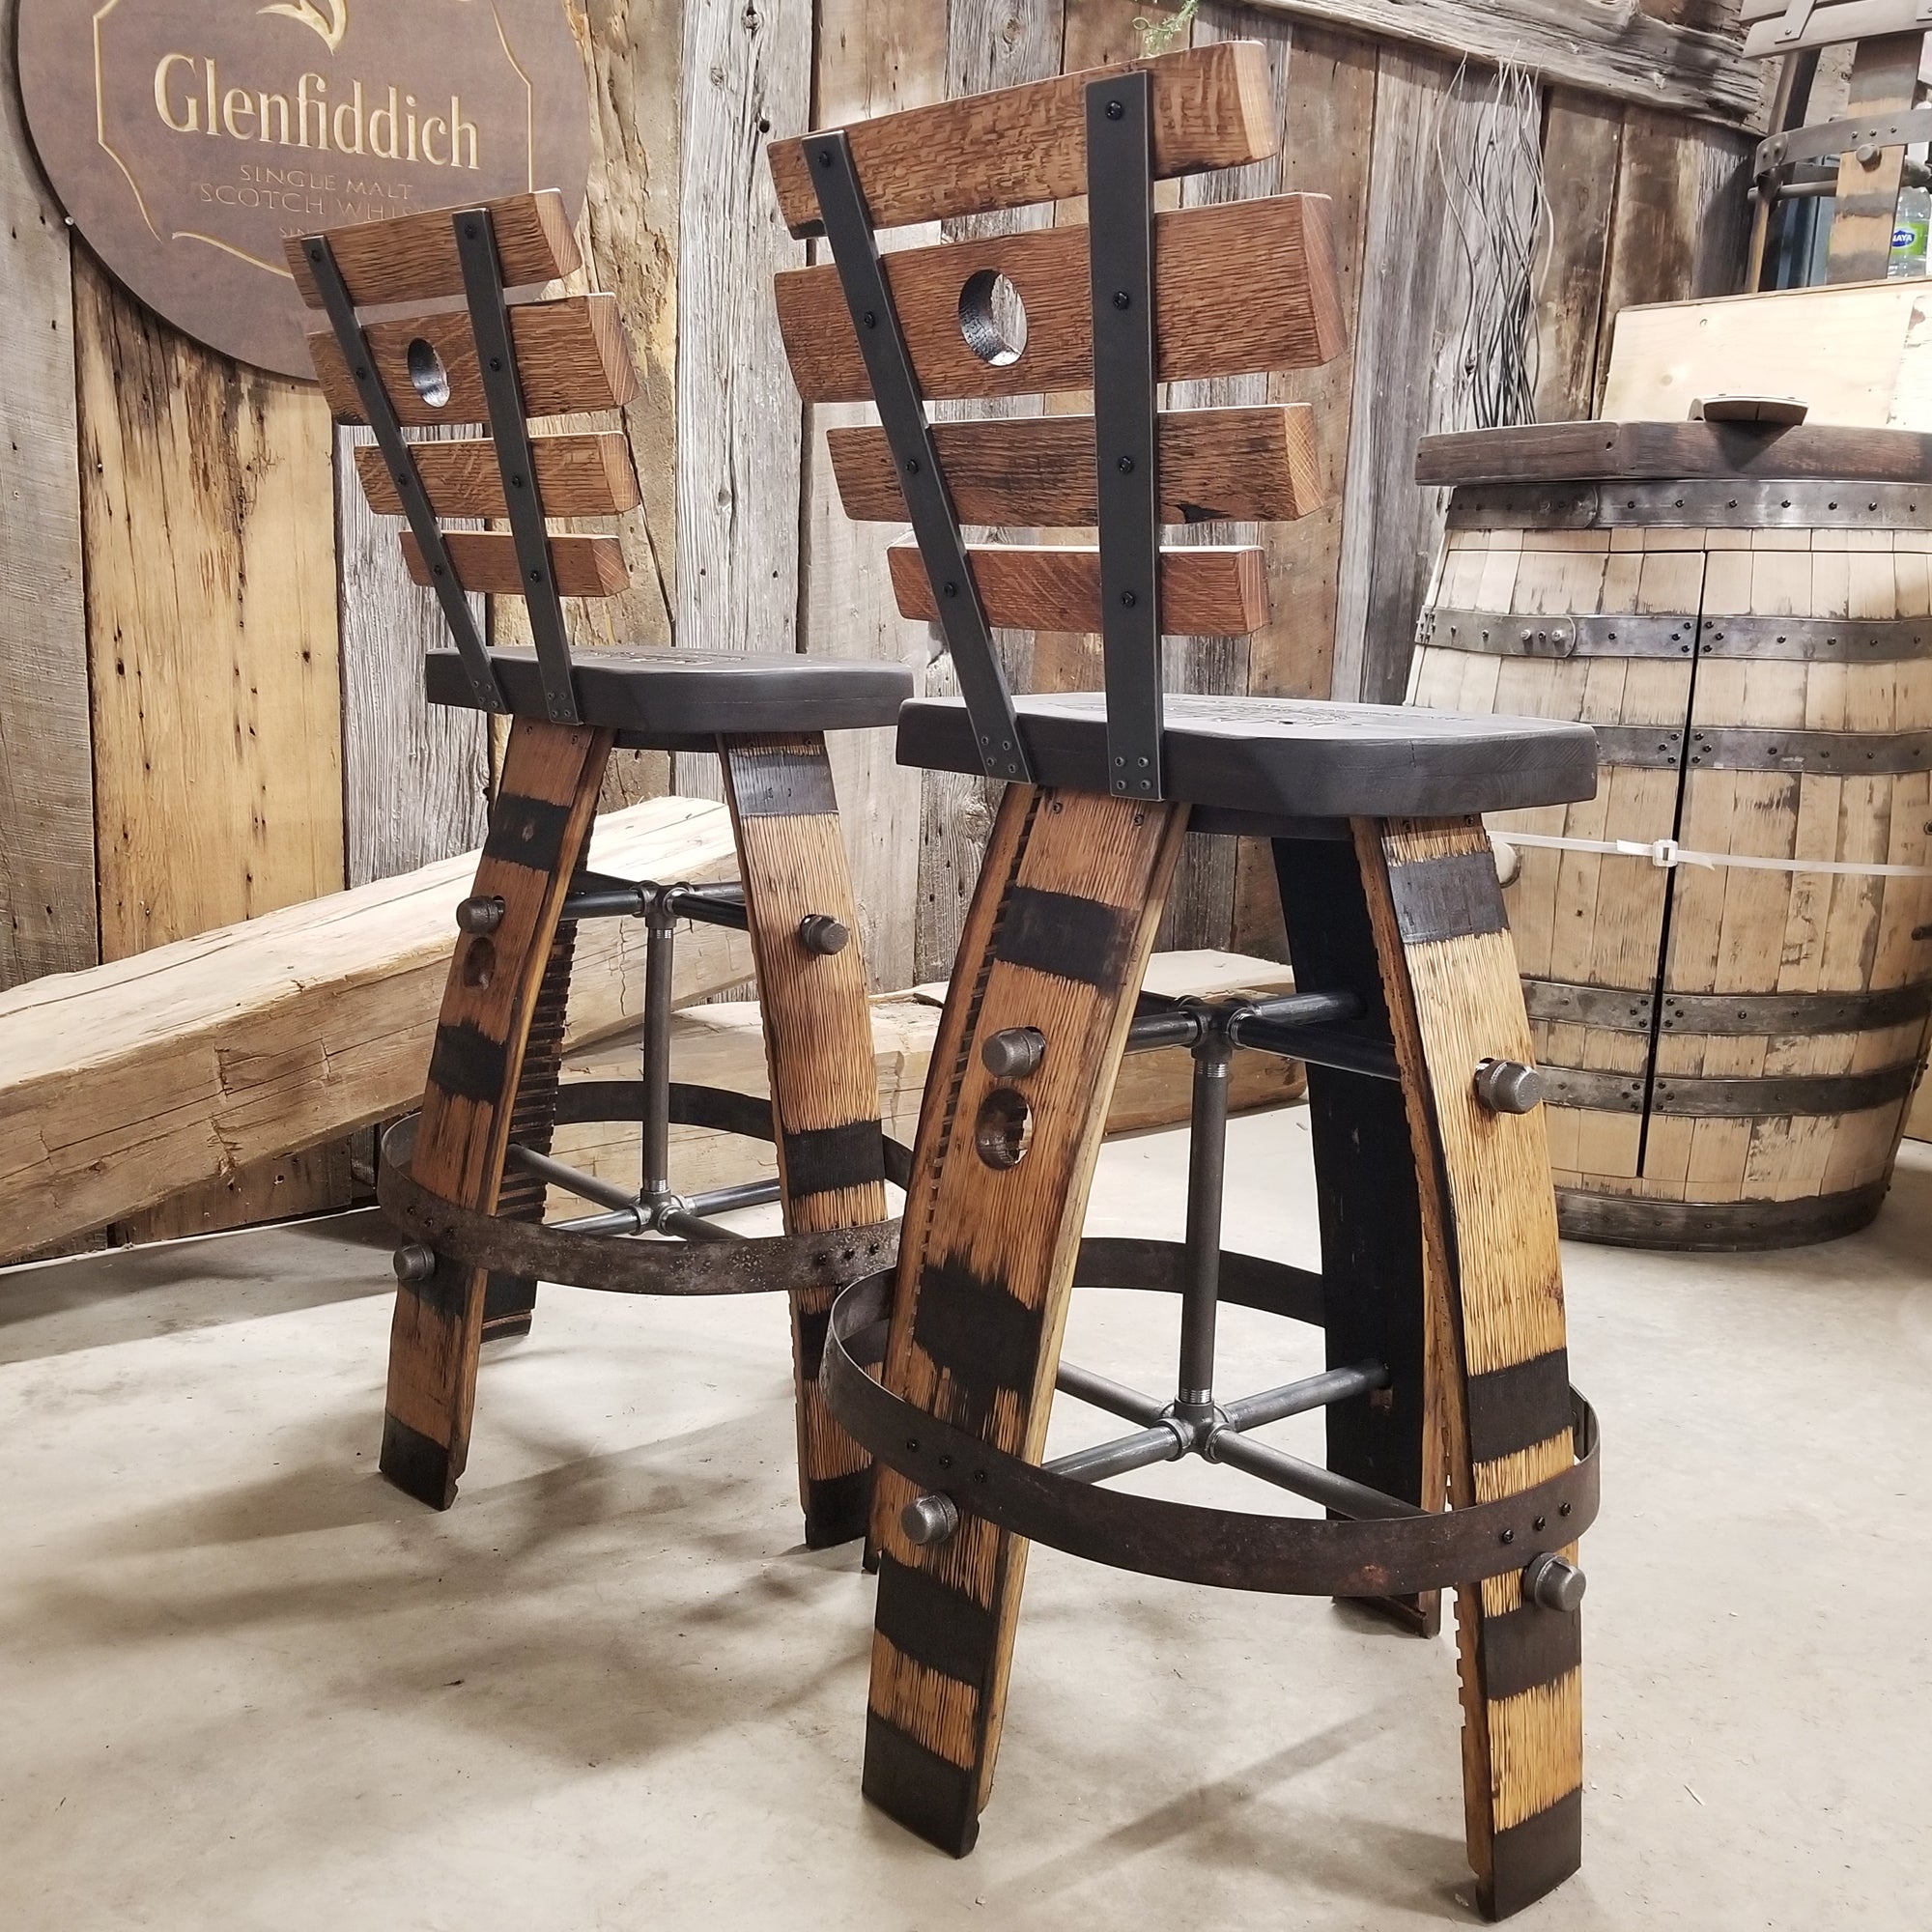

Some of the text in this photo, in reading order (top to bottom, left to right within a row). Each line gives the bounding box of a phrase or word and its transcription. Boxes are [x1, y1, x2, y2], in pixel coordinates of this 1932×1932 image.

[154, 54, 480, 169] Glenfiddich
[200, 183, 326, 214] SCOTCH
[240, 164, 413, 200] SINGLE MALT
